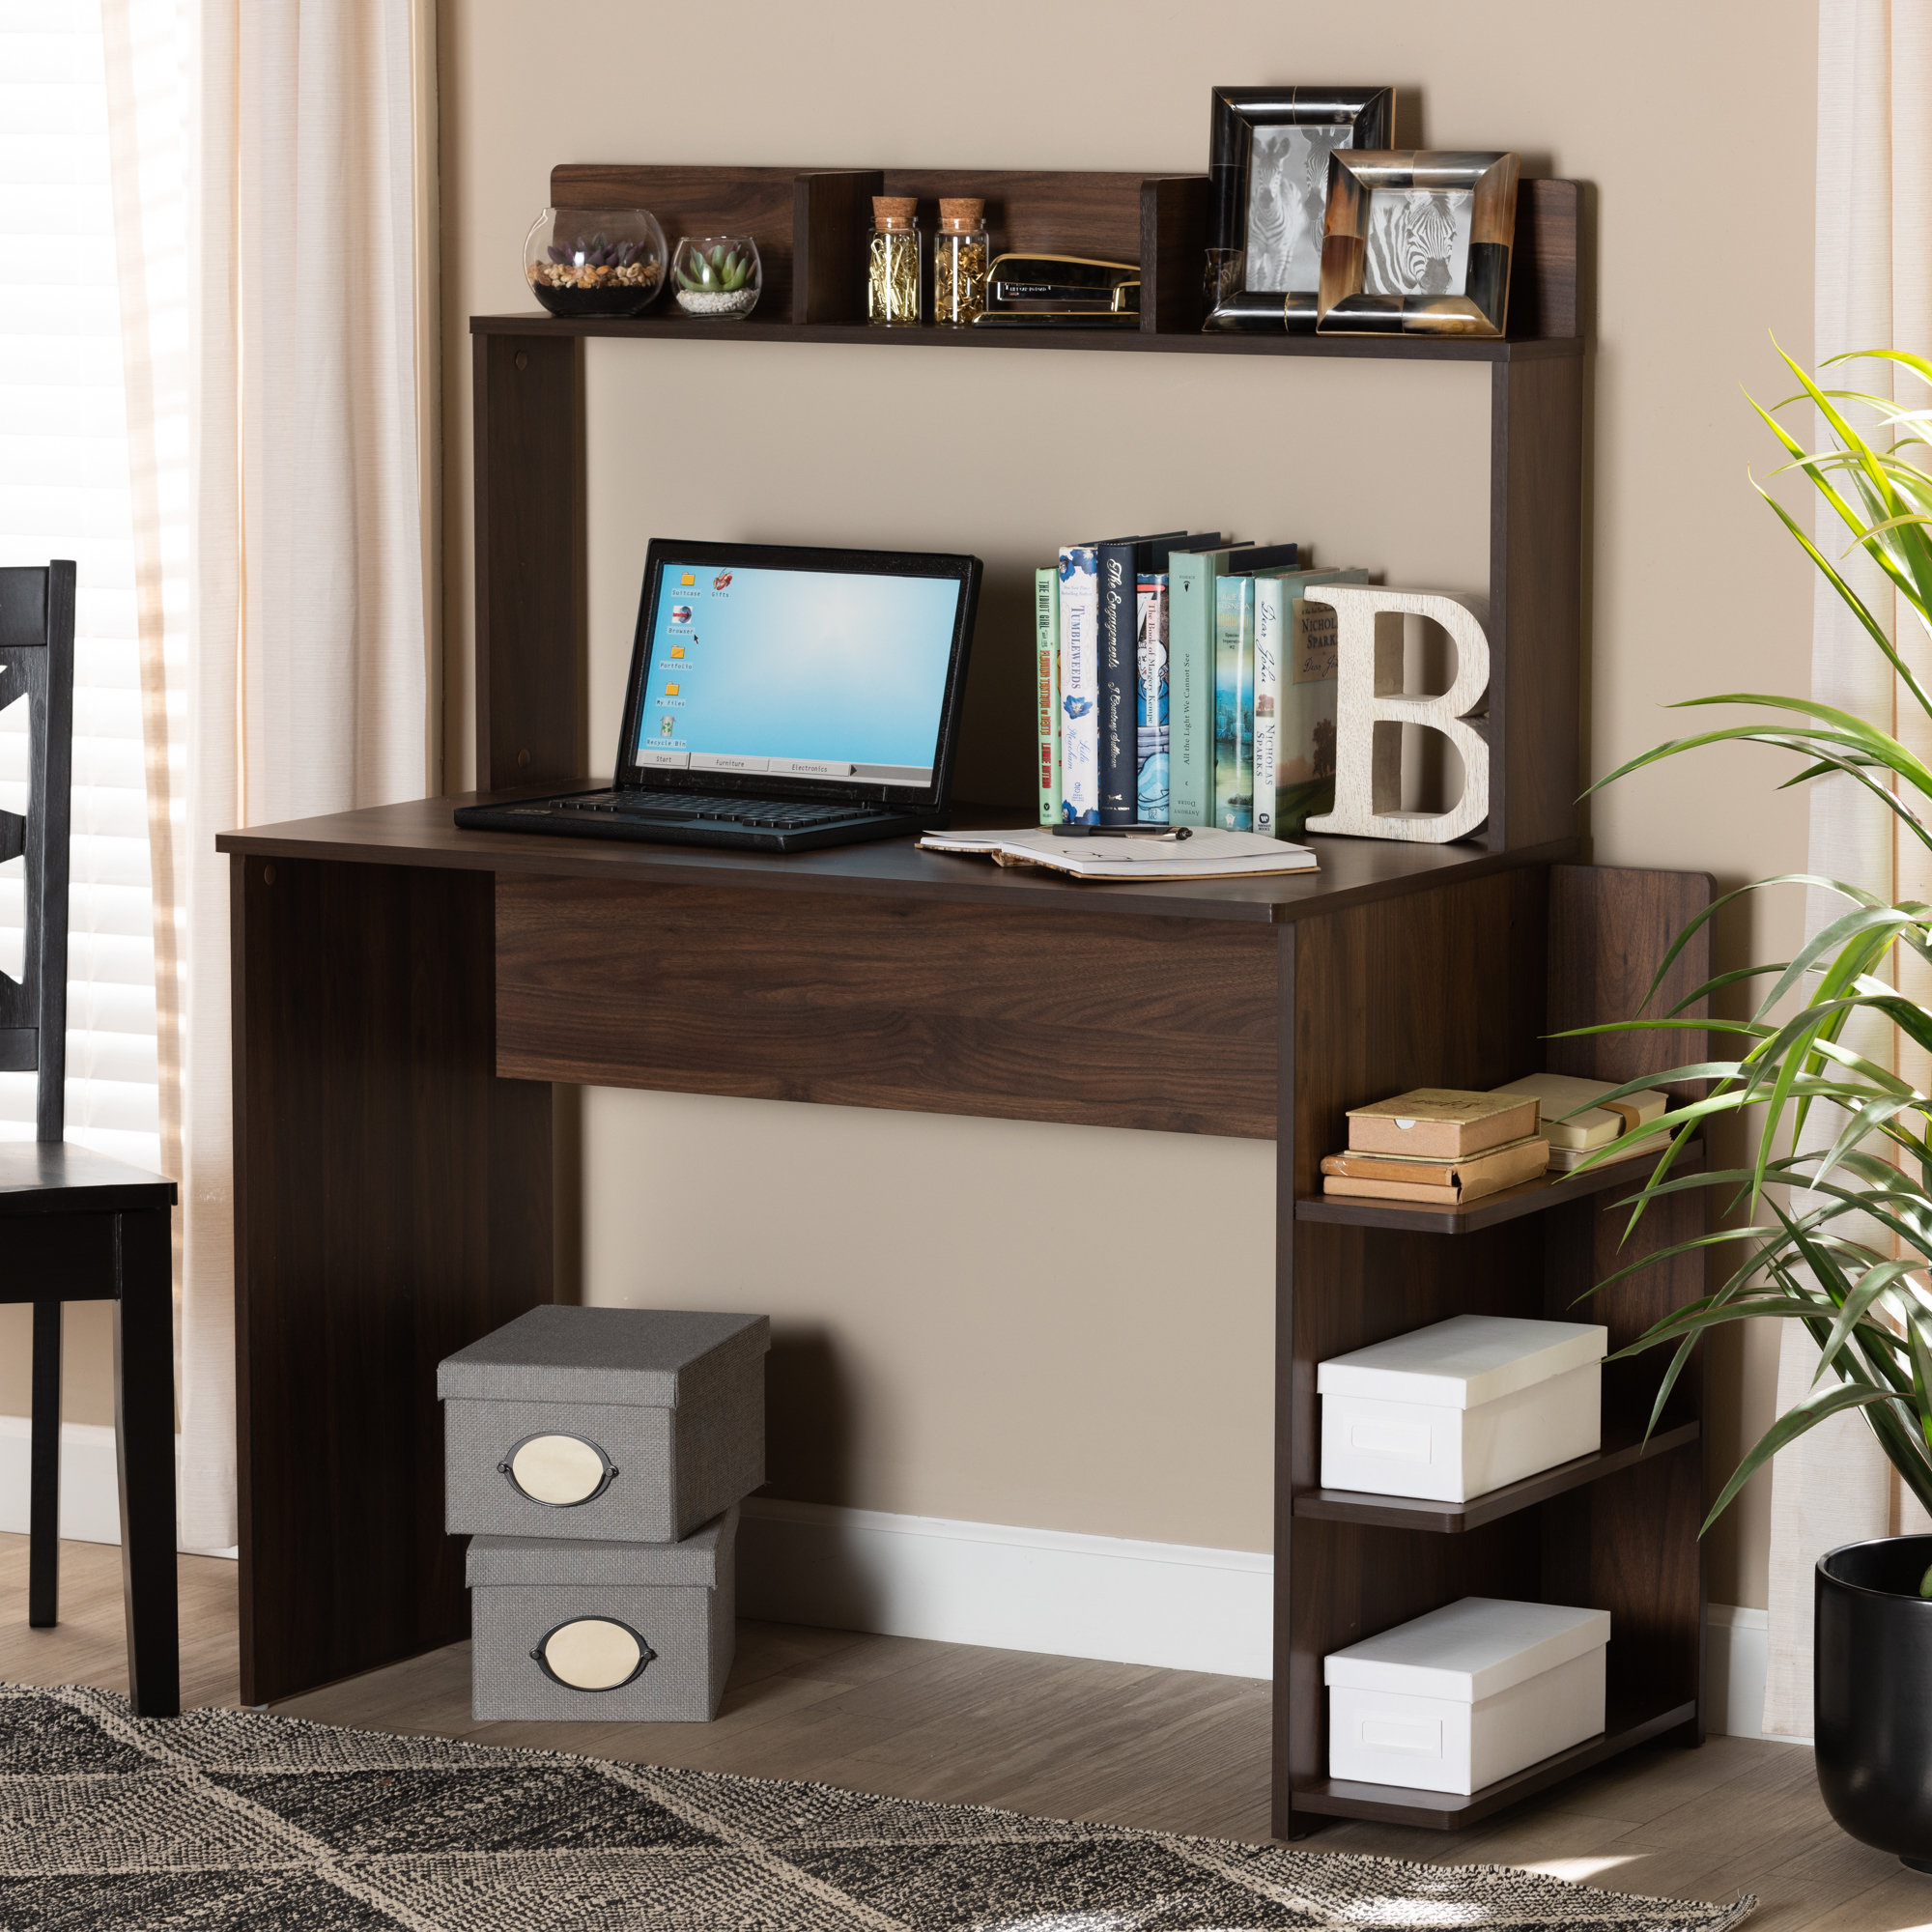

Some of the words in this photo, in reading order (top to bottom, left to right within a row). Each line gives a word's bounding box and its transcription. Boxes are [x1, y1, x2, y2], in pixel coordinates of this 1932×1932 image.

[1106, 558, 1122, 588] The
[1038, 581, 1050, 592] THE
[1038, 595, 1050, 612] IDIOT
[1148, 604, 1156, 619] The
[1038, 614, 1050, 630] GIRL
[1104, 591, 1122, 668] Engagements
[1261, 601, 1276, 638] Dear
[1301, 617, 1338, 634] NICHOL
[1148, 622, 1156, 644] Book
[1306, 634, 1338, 649] SPARK
[1071, 605, 1085, 689] TUMBLEWEEDS
[1148, 646, 1156, 656] of
[1255, 639, 1276, 684] John
[1321, 654, 1338, 677] Jo
[1147, 658, 1156, 693] Margery
[1147, 696, 1156, 724] Kempe
[1183, 700, 1190, 713] We
[1183, 715, 1192, 736] Light
[716, 759, 745, 768] Furniture
[1256, 731, 1265, 777] SPARKS
[1265, 724, 1275, 785] NICHOLAS
[791, 763, 828, 773] Electronics
